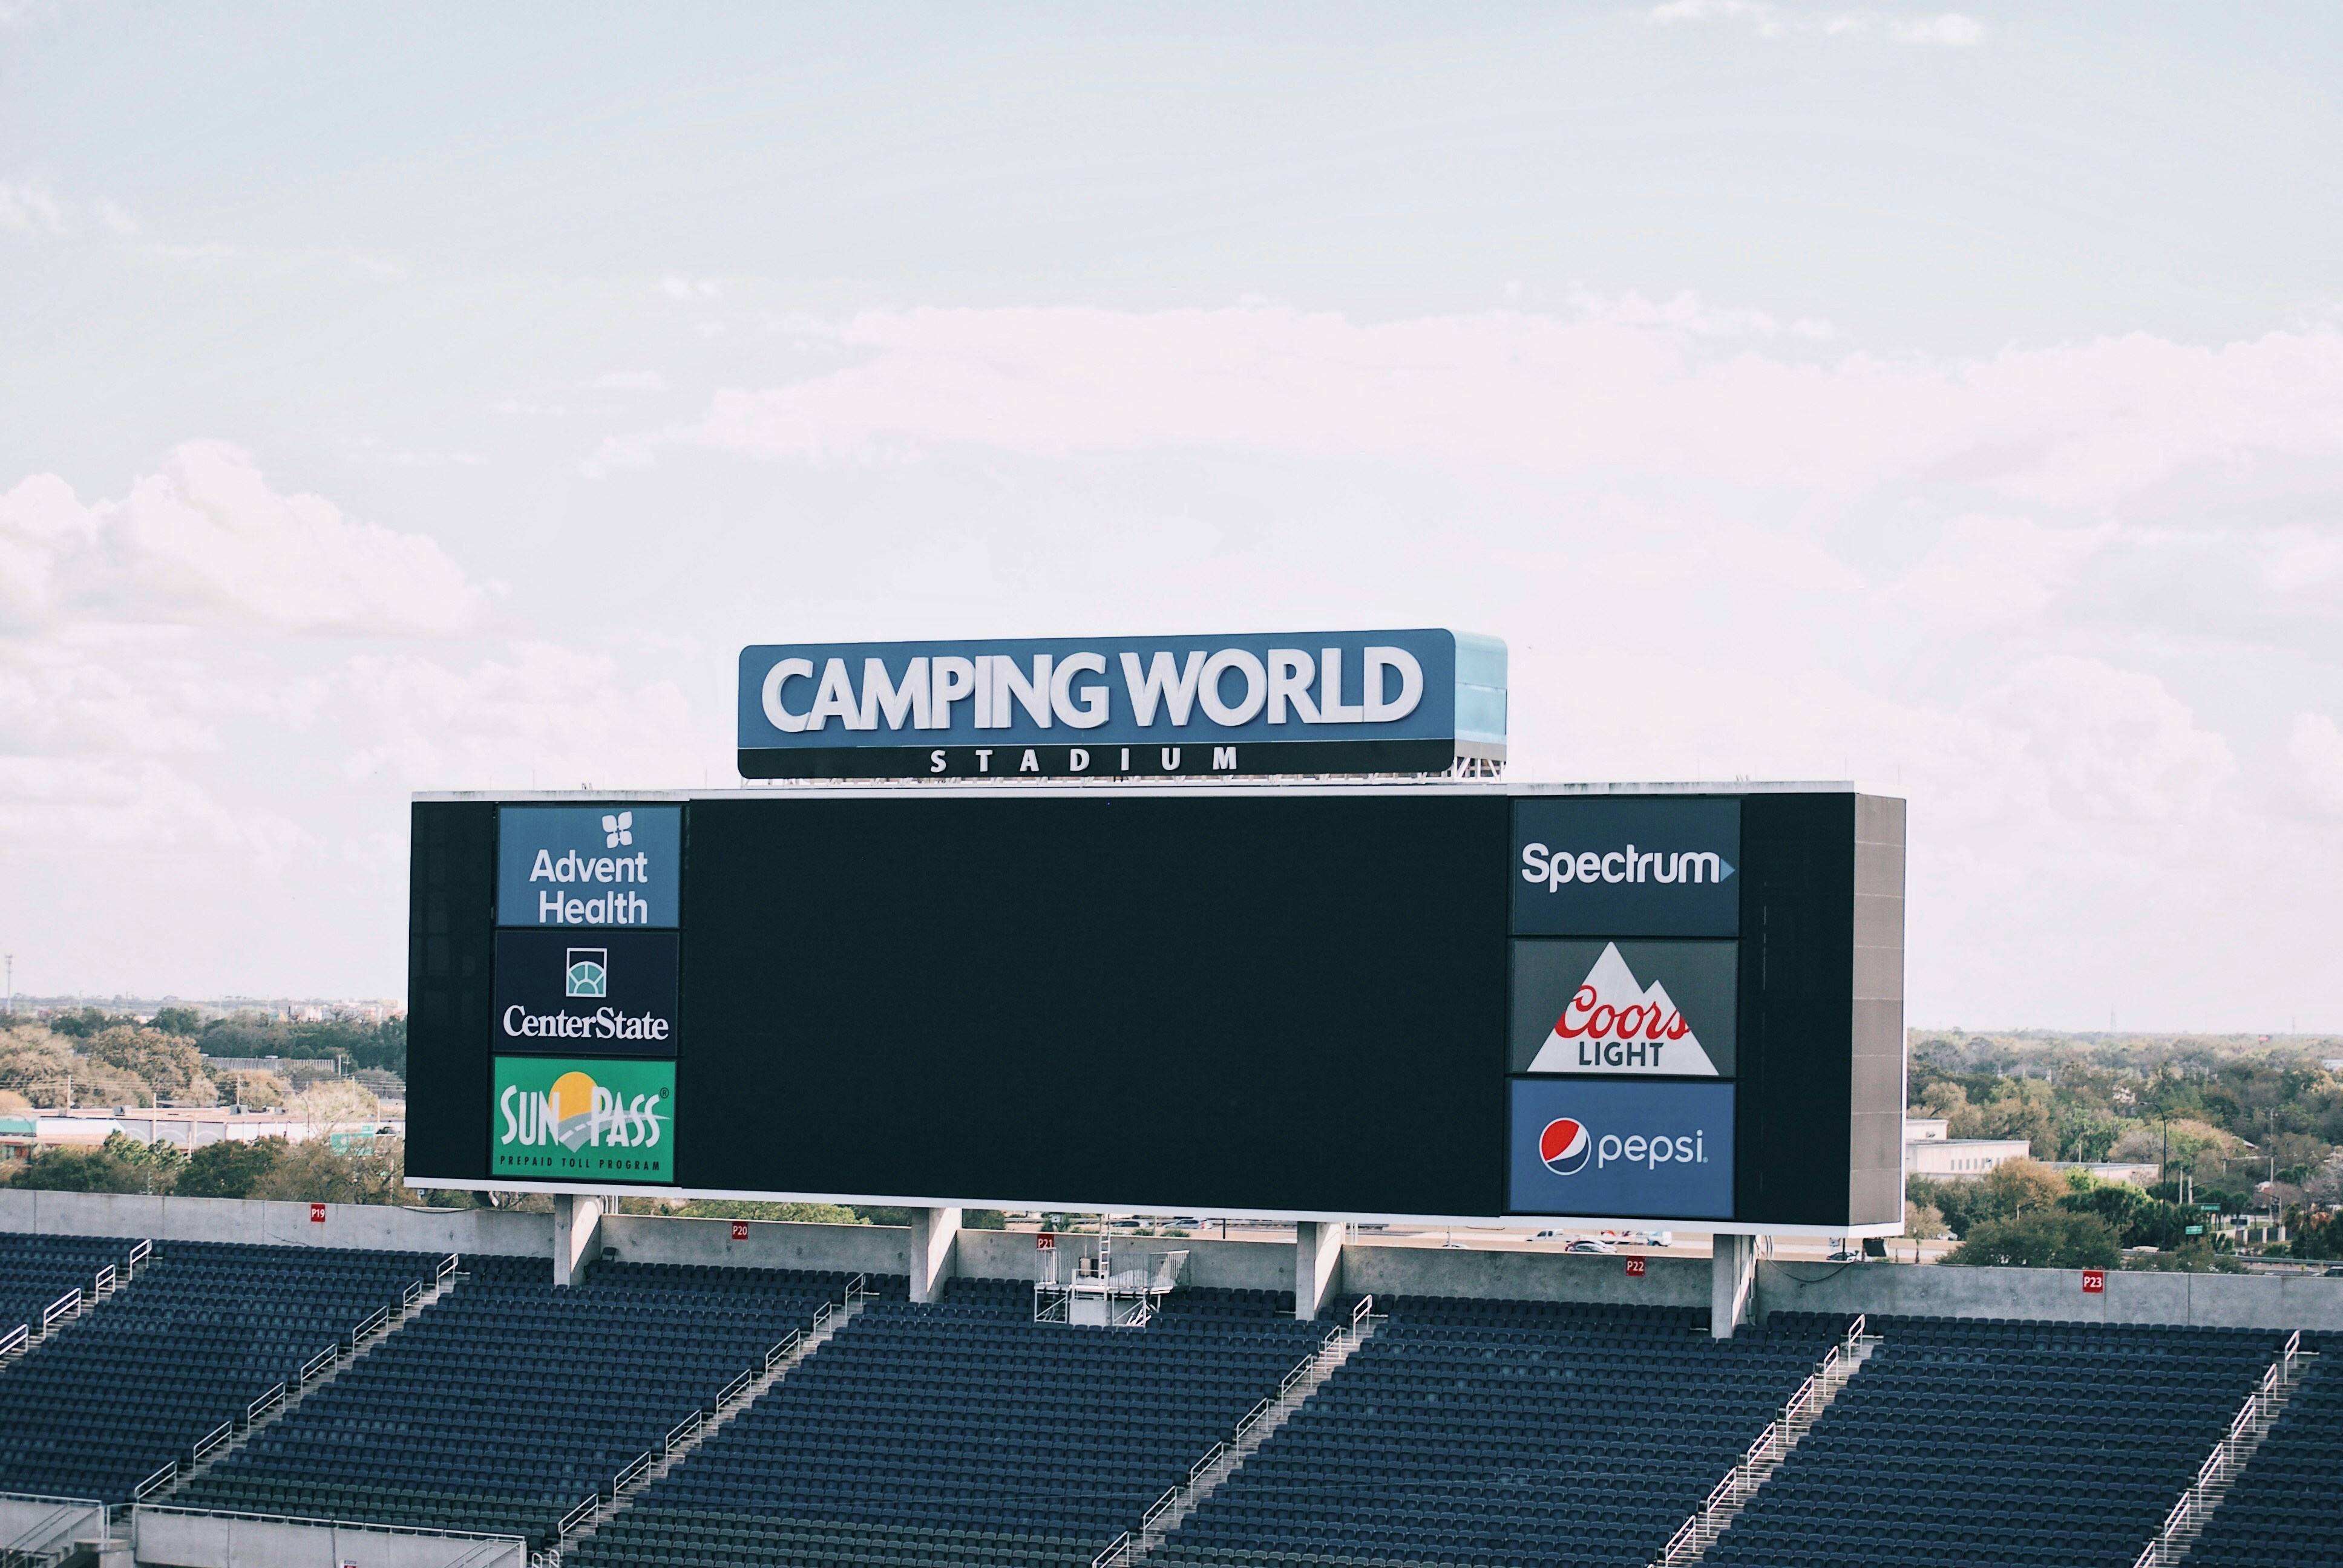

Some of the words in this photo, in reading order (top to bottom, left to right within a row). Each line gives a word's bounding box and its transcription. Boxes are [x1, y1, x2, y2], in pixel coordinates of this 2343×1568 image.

[762, 652, 1109, 733] CAMPING
[1119, 646, 1424, 727] WORLD
[931, 746, 1237, 773] STADIUM
[529, 849, 648, 883] Advent
[1521, 843, 1720, 893] Spectrum
[539, 890, 647, 924] Health
[503, 1005, 669, 1040] CenterState
[1555, 985, 1691, 1040] Coors
[1579, 1041, 1664, 1067] LIGHT
[500, 1155, 553, 1167] PREPAID
[562, 1158, 591, 1168] TOLL
[599, 1160, 660, 1171] PROGRAM
[1598, 1129, 1703, 1170] pepsi
[312, 1208, 325, 1218] P19
[733, 1226, 748, 1235] P20
[1038, 1238, 1053, 1248] P21
[1627, 1261, 1644, 1272] P22
[2084, 1276, 2102, 1287] P23
